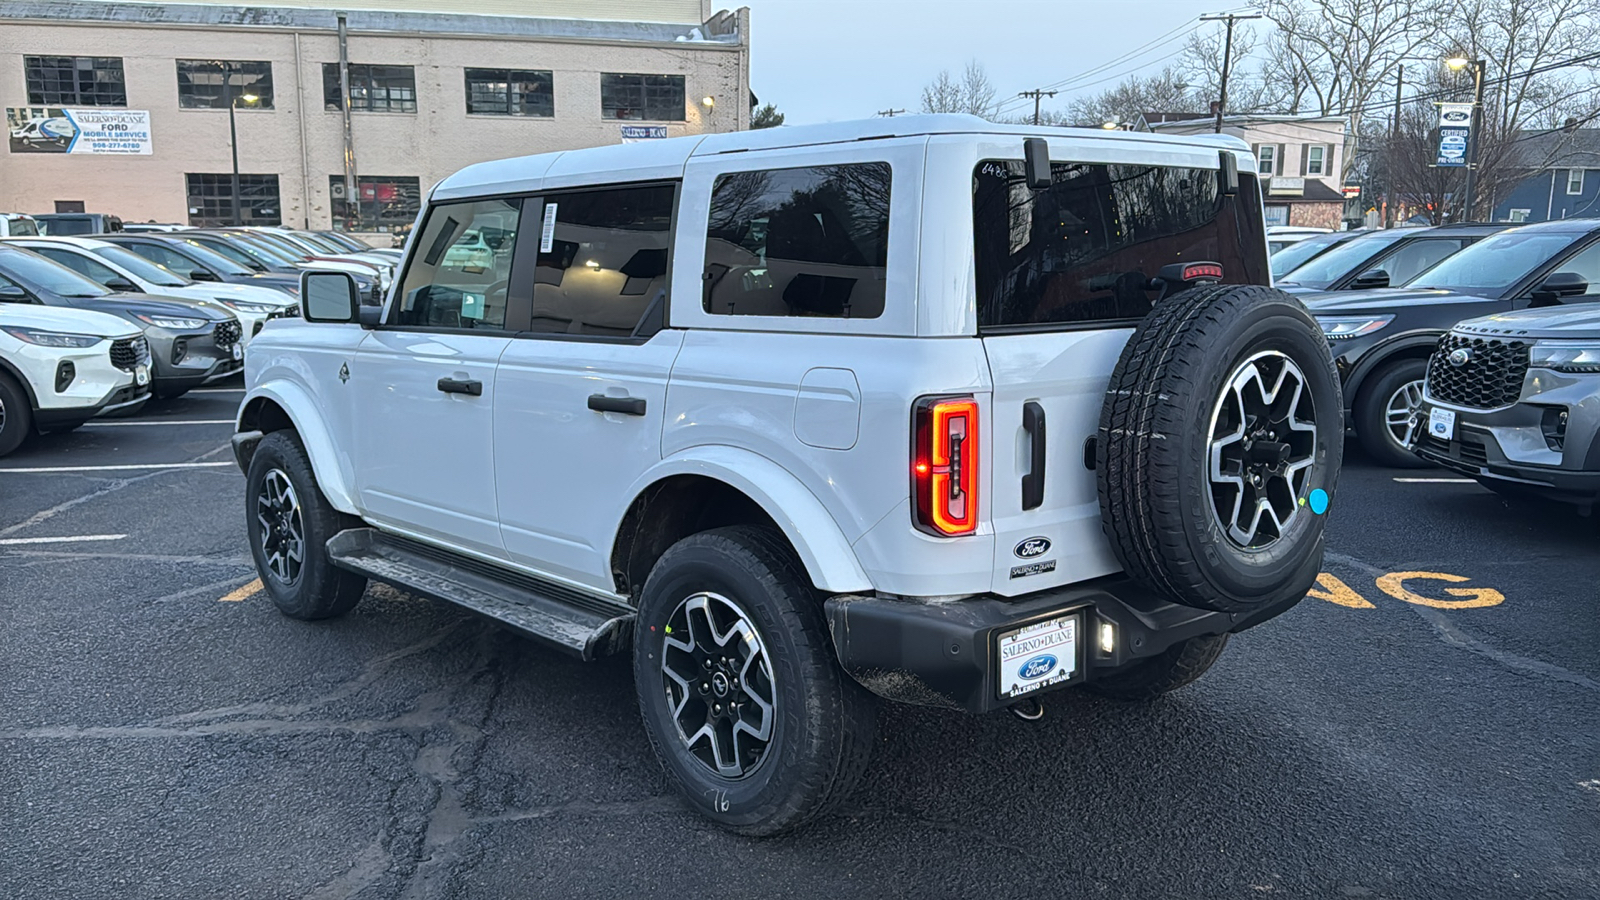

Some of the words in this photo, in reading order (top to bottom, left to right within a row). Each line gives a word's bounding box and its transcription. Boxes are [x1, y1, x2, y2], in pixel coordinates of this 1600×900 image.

[78, 115, 113, 123] SALERNO
[118, 115, 145, 123] DUANE
[1441, 129, 1468, 137] CERTIFIED
[1002, 638, 1040, 659] SALERNO
[1044, 629, 1073, 646] DUANE
[1025, 658, 1051, 677] Ford
[1009, 682, 1040, 697] SALERNO
[1049, 672, 1071, 685] DUANE
